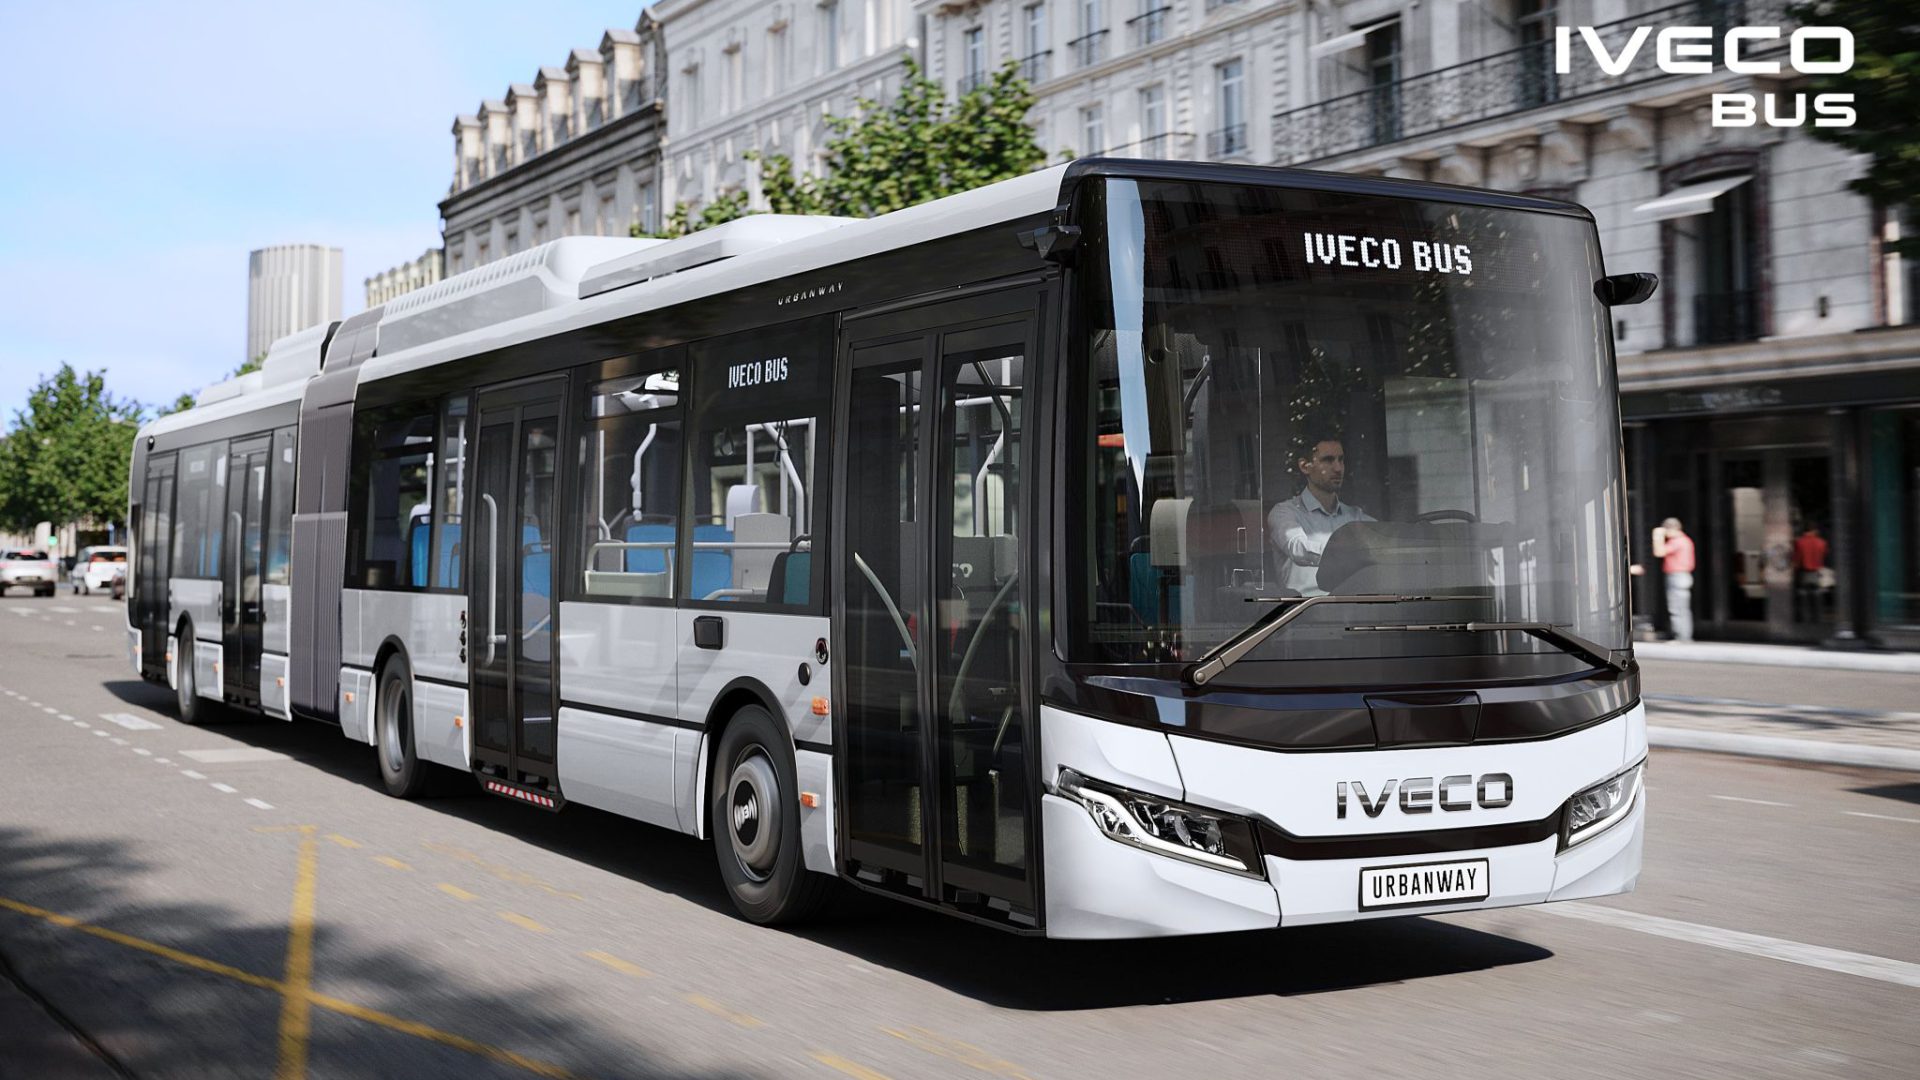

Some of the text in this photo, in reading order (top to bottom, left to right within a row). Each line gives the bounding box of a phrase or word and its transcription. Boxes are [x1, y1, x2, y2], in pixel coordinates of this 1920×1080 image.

[1304, 232, 1472, 275] IVECO BUS
[778, 281, 844, 306] URBANWAY
[728, 357, 788, 389] IVECO BUS
[1336, 772, 1514, 819] IVECO
[1373, 868, 1477, 899] URBANWAY
